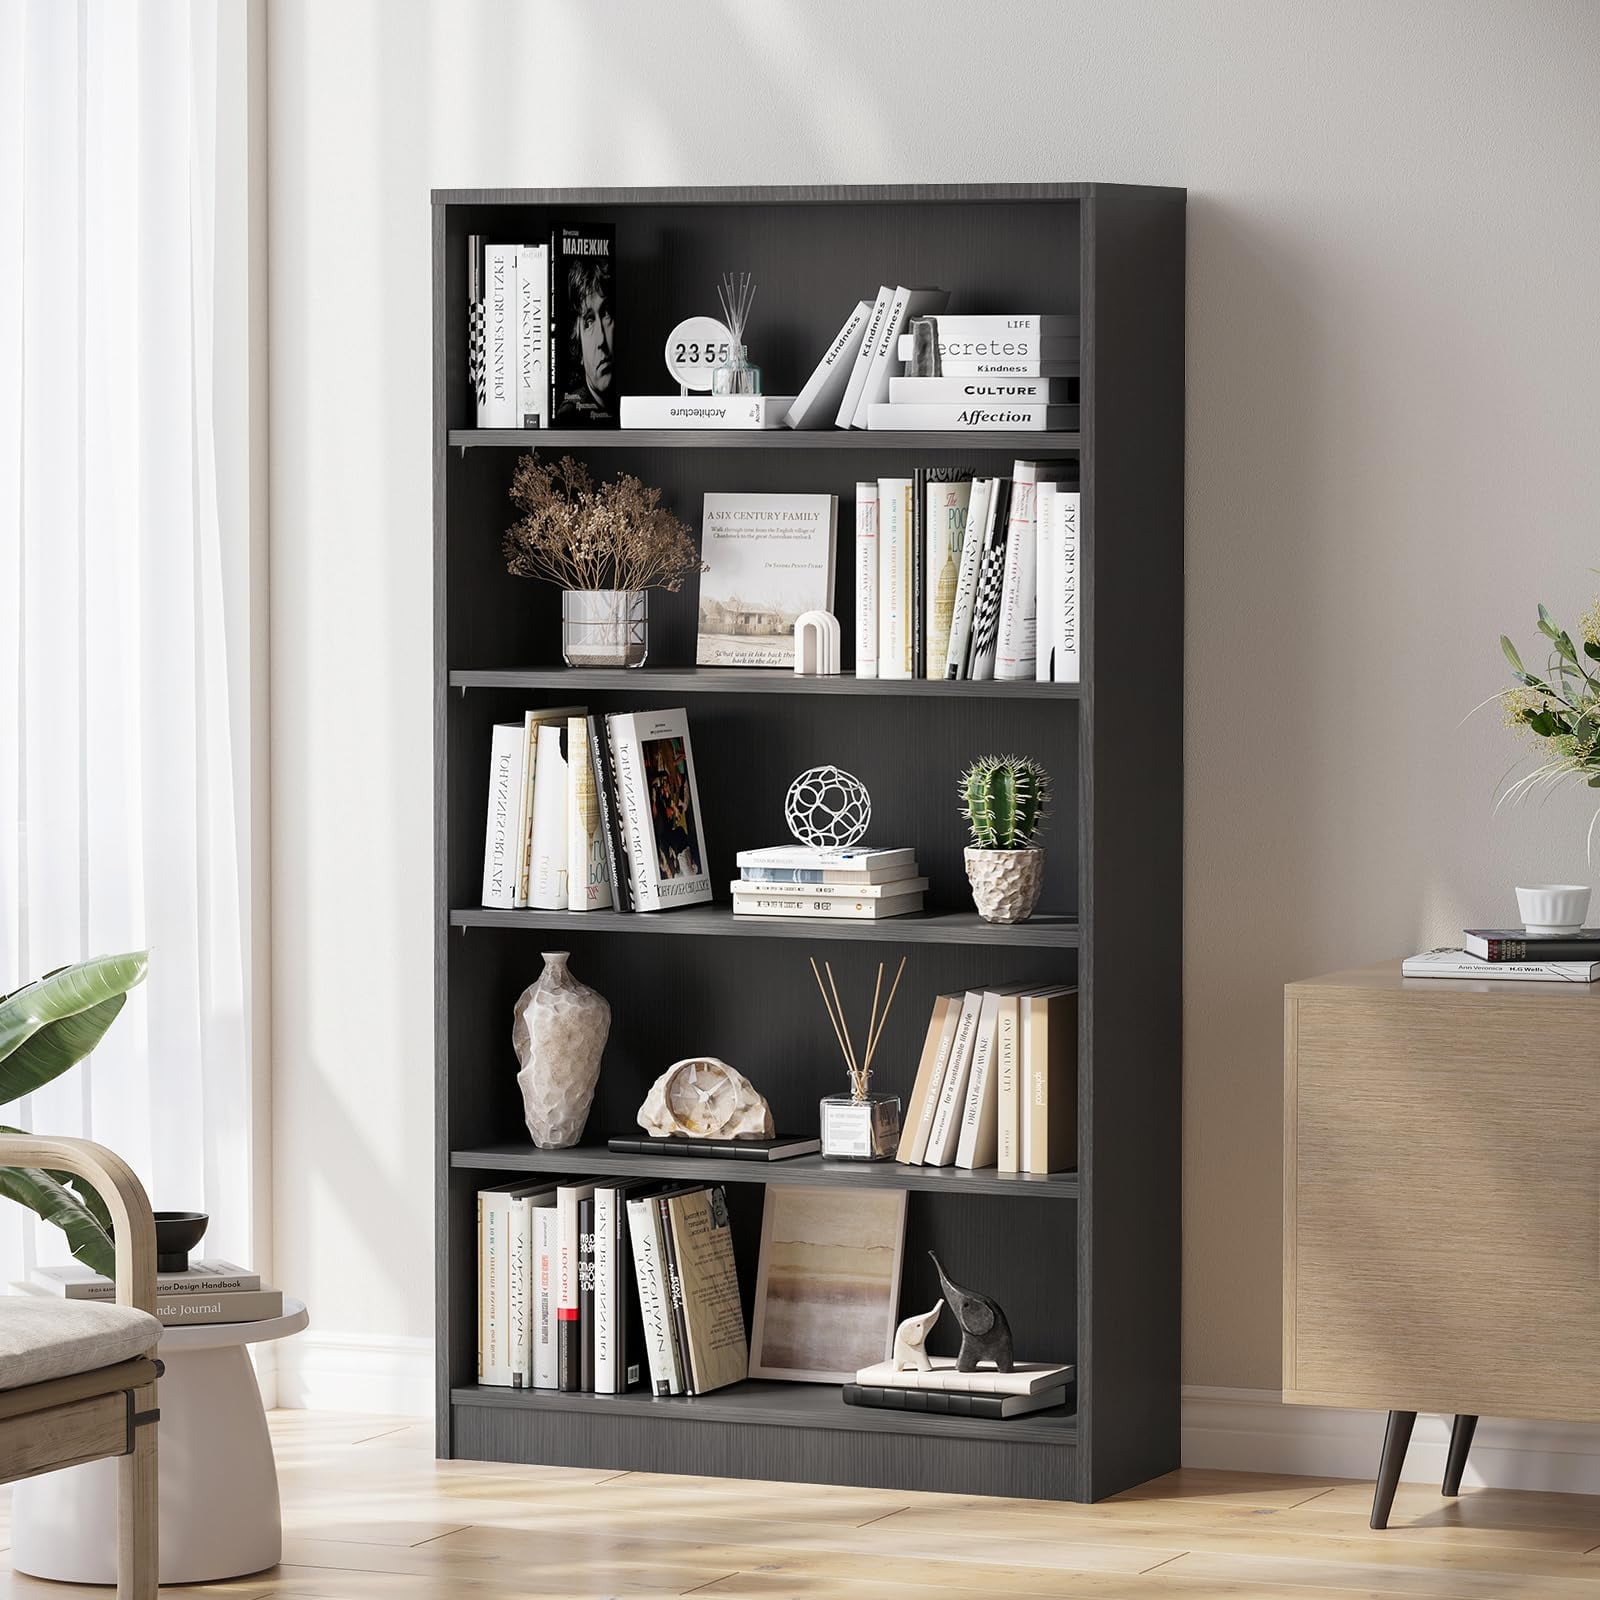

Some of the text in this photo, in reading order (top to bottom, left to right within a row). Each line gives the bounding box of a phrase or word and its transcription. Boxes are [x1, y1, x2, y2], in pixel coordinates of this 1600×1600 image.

[562, 238, 610, 256] МАЛЕЖИК
[862, 301, 886, 357] Kindness
[879, 301, 902, 357] Kindness
[1008, 320, 1030, 329] LIFE
[826, 316, 860, 366] Kindness
[938, 340, 1028, 356] ecretes
[494, 326, 505, 401] JOHANNES
[670, 408, 726, 418] Architecture
[957, 410, 1032, 425] Affection
[944, 492, 958, 507] The
[707, 512, 820, 520] A SIX CENTURY FAMILY
[1064, 576, 1076, 653] JOHANNES
[1004, 1018, 1011, 1032] ON
[944, 1092, 952, 1104] for
[950, 1043, 965, 1085] sustainable
[960, 1012, 973, 1042] lifestyle
[967, 1094, 979, 1126] DREAM
[979, 1038, 989, 1067] AWAKE
[174, 1282, 200, 1291] Design
[202, 1280, 241, 1289] Handbook
[157, 1303, 221, 1316] nde Journal
